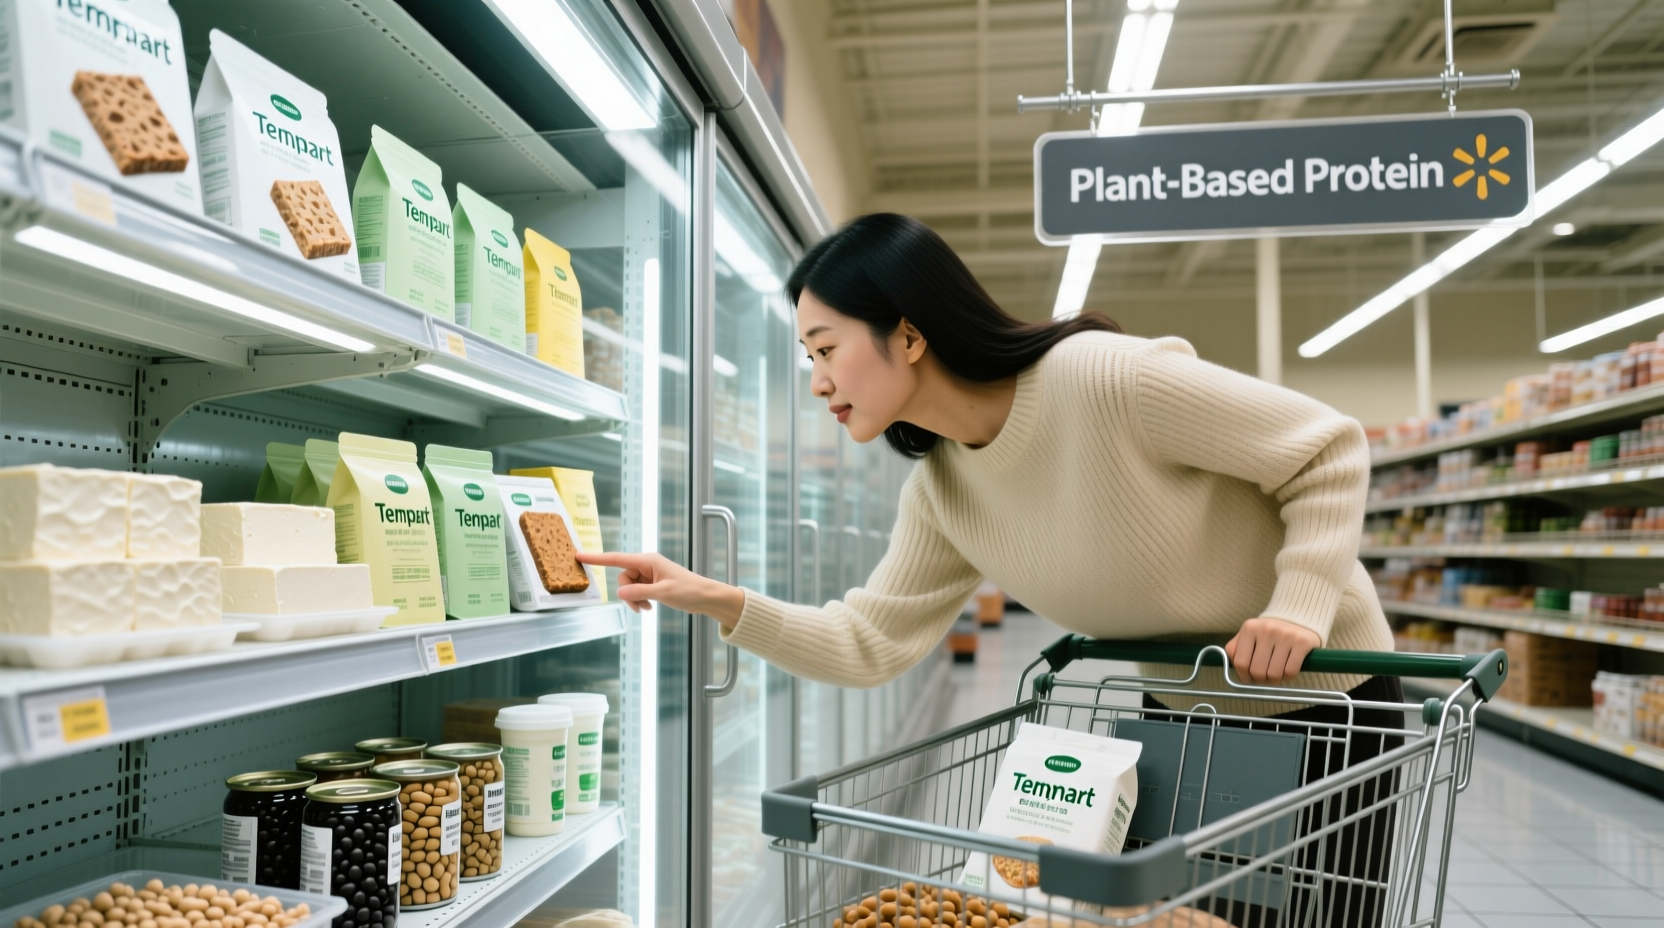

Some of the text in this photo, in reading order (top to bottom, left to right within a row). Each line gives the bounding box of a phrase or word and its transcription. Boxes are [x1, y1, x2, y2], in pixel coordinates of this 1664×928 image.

[252, 110, 334, 166] Tempart
[1070, 153, 1444, 203] Plant-Based Protein
